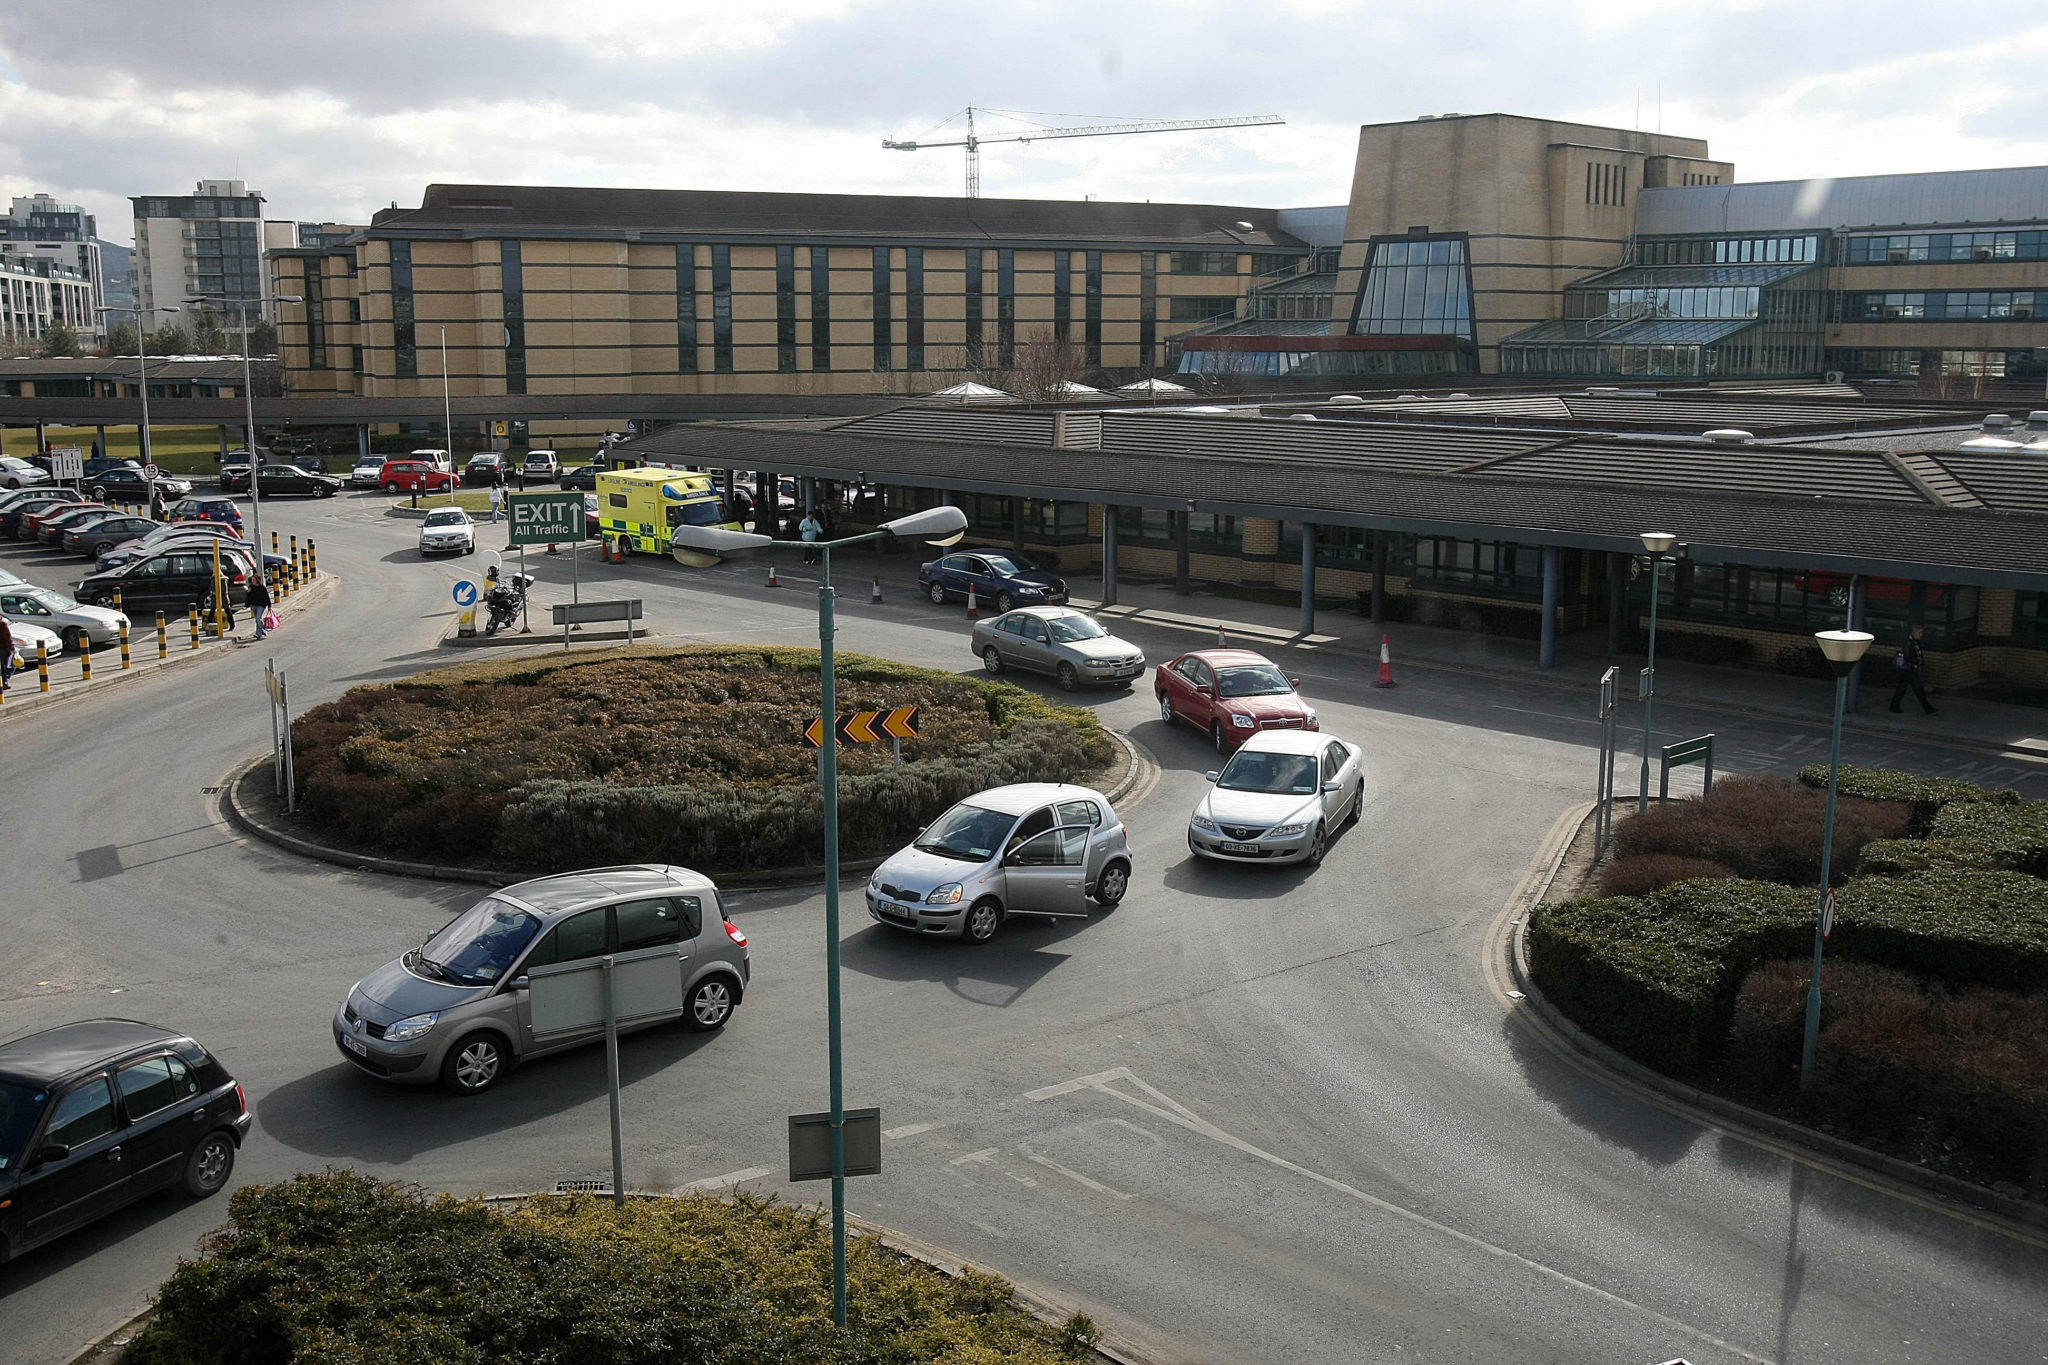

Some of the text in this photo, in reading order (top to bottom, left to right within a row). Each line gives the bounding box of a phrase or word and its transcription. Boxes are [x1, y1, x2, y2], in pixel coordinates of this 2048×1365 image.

[147, 465, 156, 473] 15
[686, 491, 710, 499] AMBULANCE
[514, 502, 567, 523] EXIT
[514, 524, 569, 536] All Traffic
